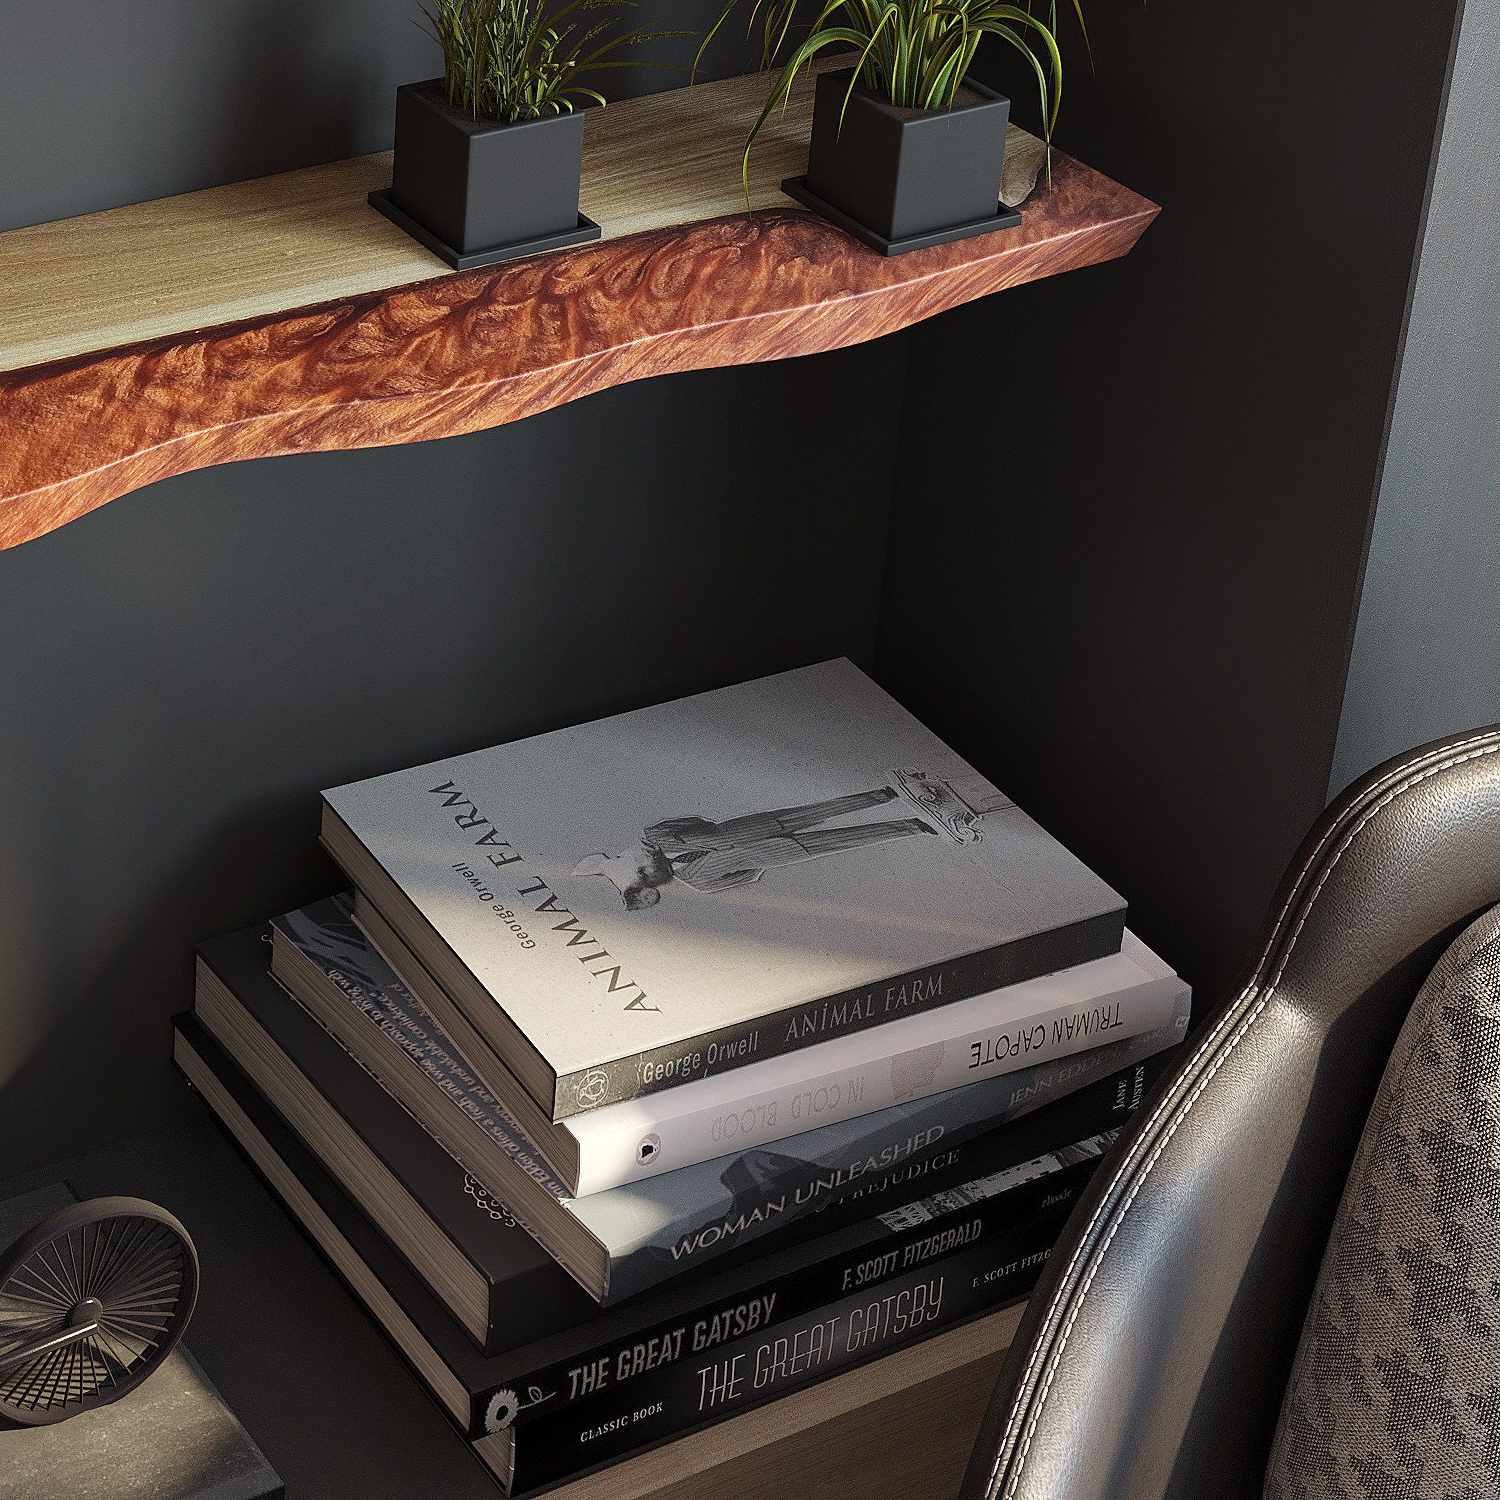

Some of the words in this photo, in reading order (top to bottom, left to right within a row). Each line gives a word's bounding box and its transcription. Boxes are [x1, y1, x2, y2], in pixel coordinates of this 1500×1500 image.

[428, 780, 524, 870] FARM
[452, 862, 495, 902] Orwell
[493, 903, 535, 950] George
[517, 875, 662, 1014] ANIMAL
[366, 1009, 385, 1020] to
[643, 1050, 701, 1085] George
[707, 1031, 759, 1065] Orwell
[784, 1002, 875, 1043] ANIMAL
[884, 974, 943, 1013] FARM
[1051, 1001, 1122, 1045] TRUMAN
[376, 1018, 427, 1059] approach
[969, 1025, 1046, 1069] CAPOTE
[435, 1078, 462, 1097] and
[791, 1083, 840, 1119] COLD
[847, 1076, 865, 1103] IN
[1112, 1080, 1128, 1111] JANE
[1128, 1066, 1144, 1111] AUSTEN
[711, 1102, 777, 1142] BLOOD
[670, 1195, 786, 1261] WOMAN
[795, 1124, 945, 1204] UNLEASHED
[1008, 1076, 1053, 1108] JENN
[839, 1150, 960, 1204] REJUDICE
[568, 1358, 613, 1400] THE
[616, 1327, 687, 1381] GREAT
[691, 1293, 778, 1352] GATSBY
[842, 1266, 856, 1291] F.
[856, 1250, 901, 1286] SCOTT
[902, 1218, 982, 1269] FITZGERALD
[580, 1414, 630, 1443] CLASSIC
[632, 1400, 664, 1426] BOOK
[696, 1353, 747, 1411] THE
[752, 1315, 842, 1389] GREAT
[845, 1276, 945, 1355] GATSBY
[972, 1276, 980, 1288] F.
[983, 1261, 1018, 1283] SCOTT
[1021, 1248, 1051, 1269] FITZG
